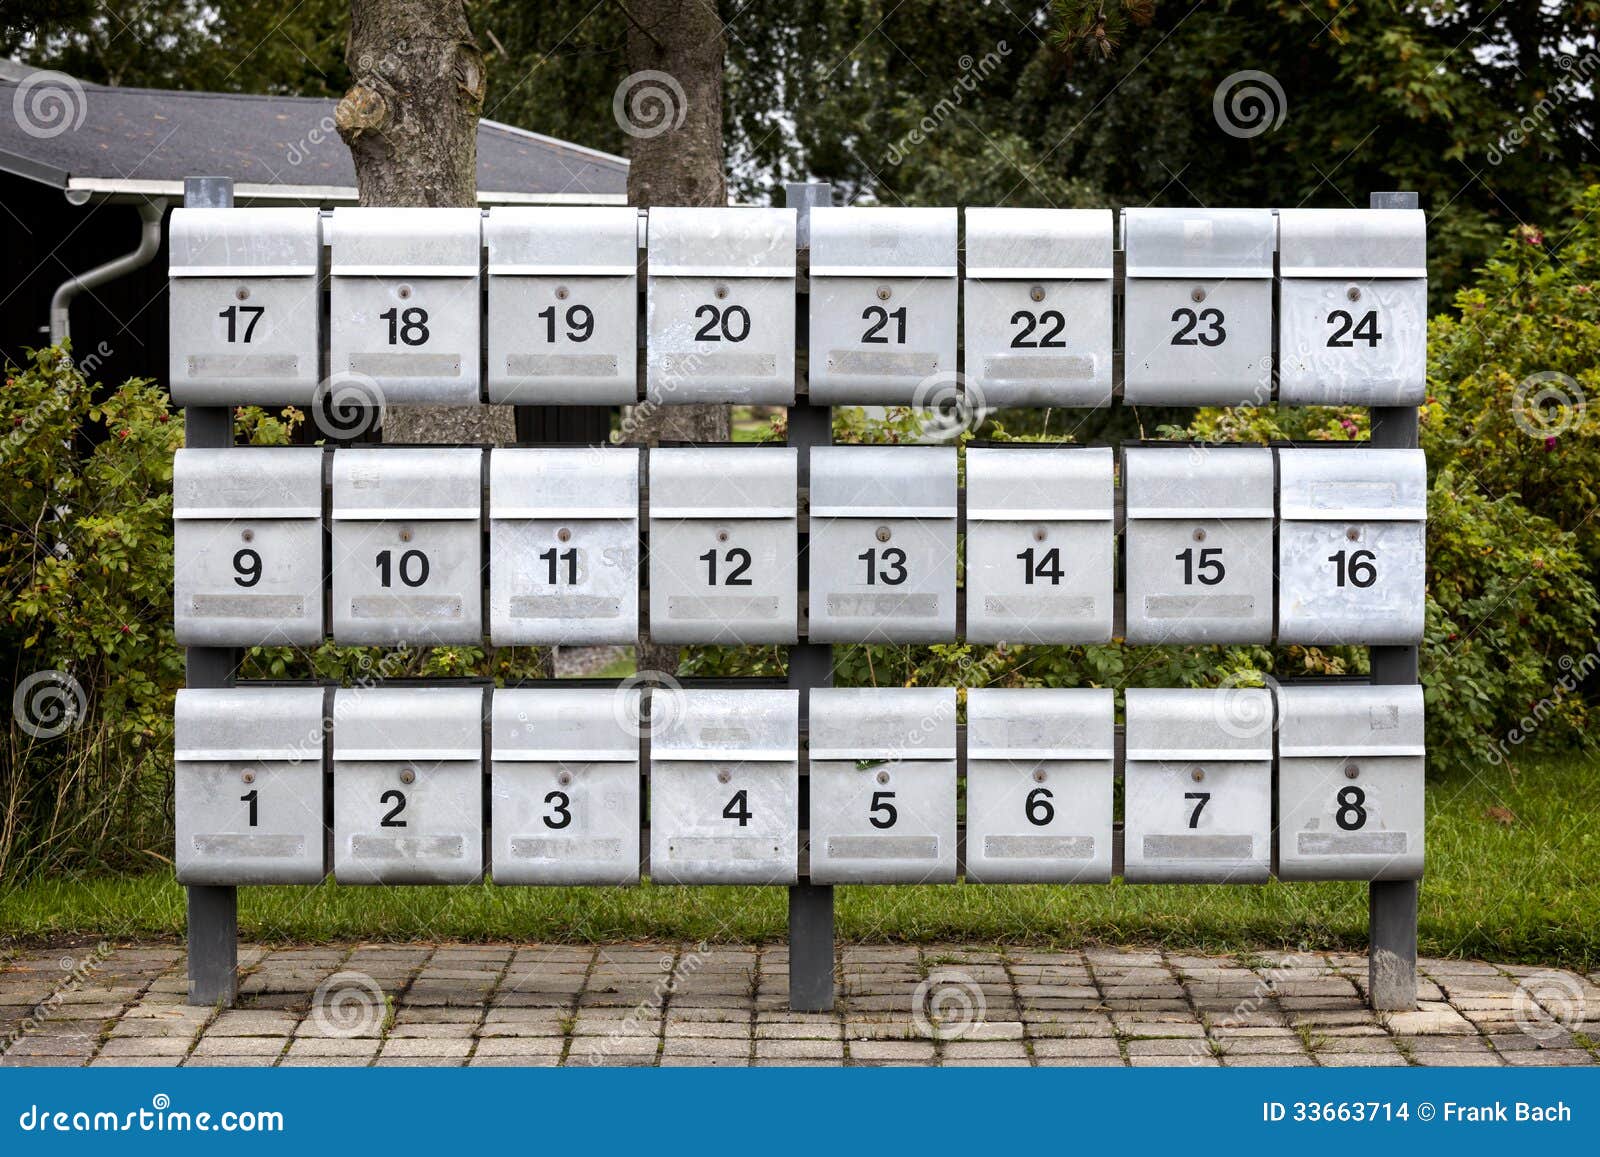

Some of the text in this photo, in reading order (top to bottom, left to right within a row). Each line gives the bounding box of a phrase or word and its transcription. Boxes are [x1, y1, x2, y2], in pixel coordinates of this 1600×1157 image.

[220, 306, 264, 342] 17
[380, 308, 429, 345] 18
[539, 305, 594, 342] 19
[695, 305, 750, 342] 20
[862, 306, 908, 343] 21
[1010, 311, 1065, 348] 22
[1171, 308, 1226, 346] 23
[1327, 310, 1382, 347] 24
[233, 549, 262, 587] 9
[376, 550, 429, 587] 10
[540, 548, 577, 584] 11
[700, 548, 752, 585] 12
[858, 548, 907, 585] 13
[1016, 548, 1064, 584] 14
[1175, 549, 1225, 585] 15
[1328, 550, 1376, 587] 16
[241, 790, 258, 826] 1
[381, 790, 407, 827] 2
[543, 791, 572, 829] 3
[723, 790, 752, 826] 4
[869, 792, 897, 828] 5
[1025, 788, 1054, 826] 6
[1184, 792, 1210, 828] 7
[1336, 787, 1366, 830] 8
